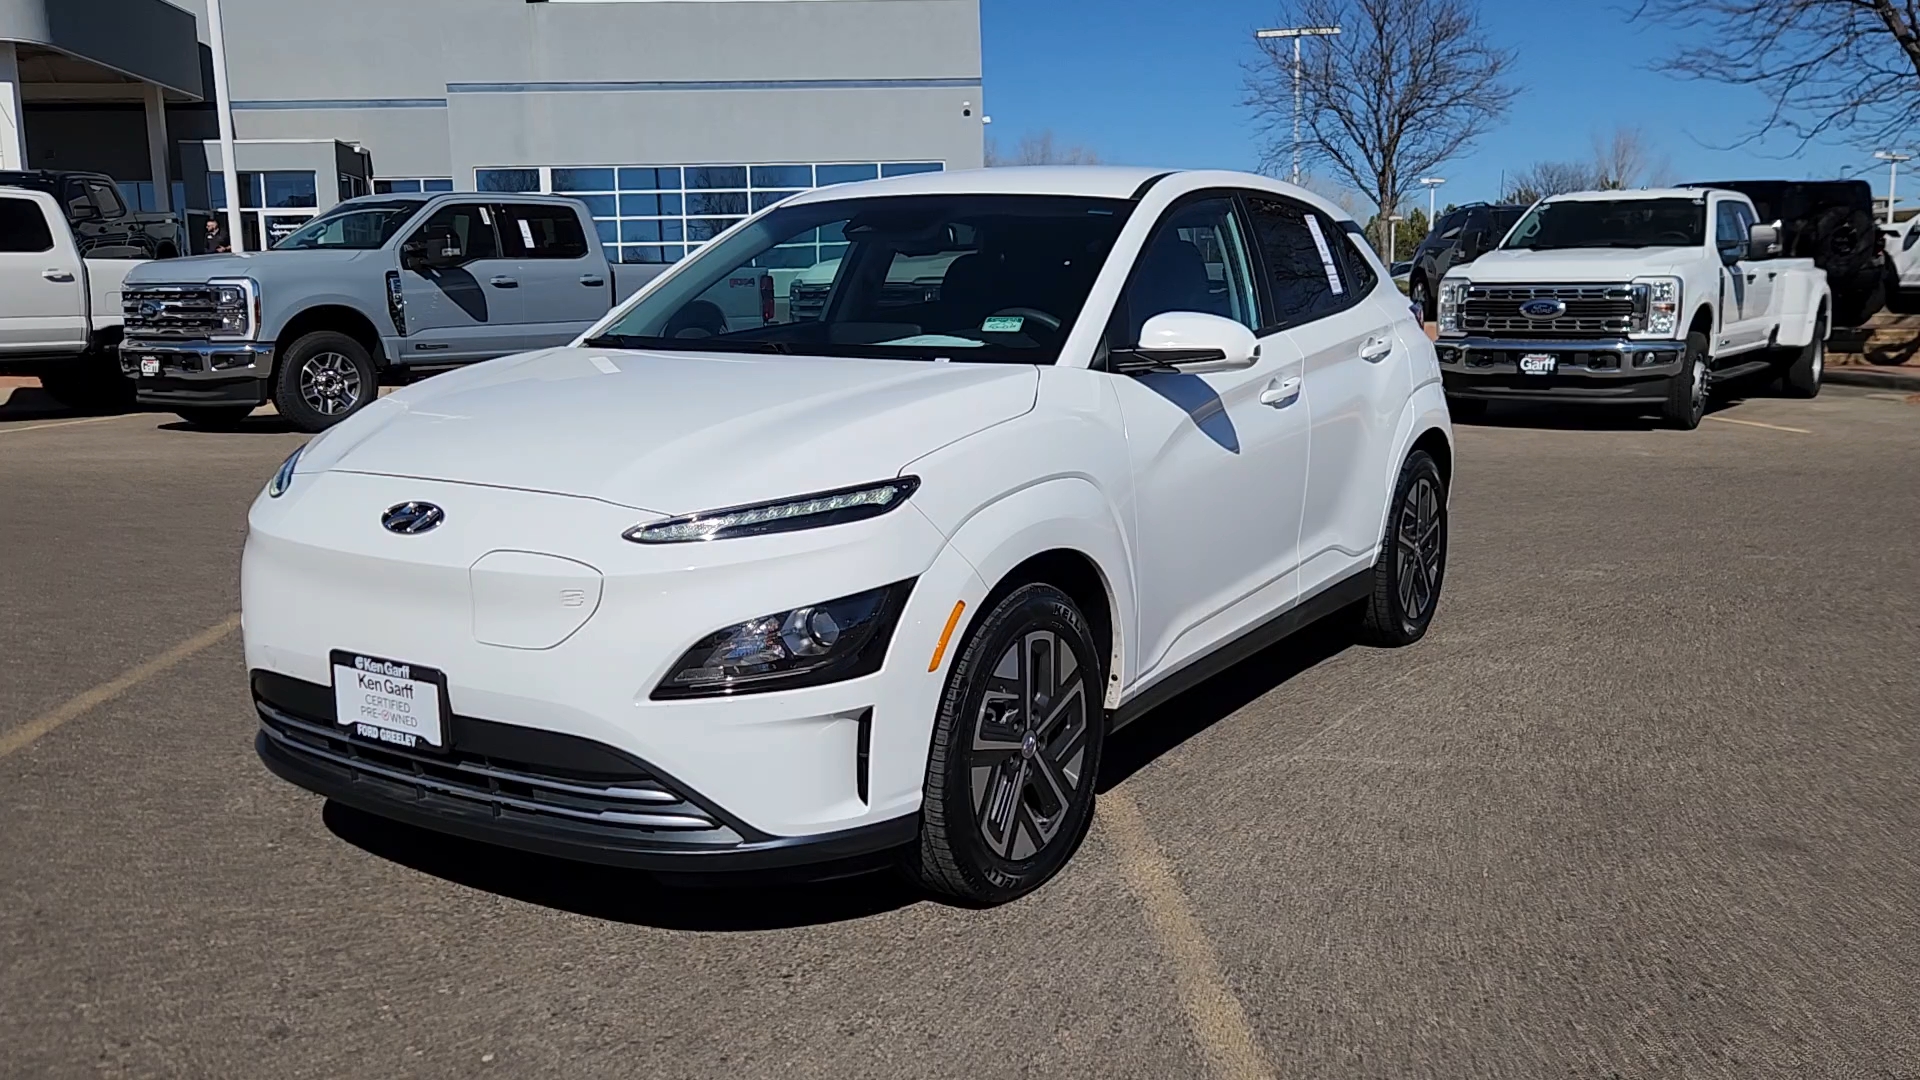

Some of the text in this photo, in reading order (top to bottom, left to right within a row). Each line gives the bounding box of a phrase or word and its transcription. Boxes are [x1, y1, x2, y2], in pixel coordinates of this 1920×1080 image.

[1520, 357, 1556, 371] Garff
[1053, 603, 1084, 633] KELLY
[364, 658, 410, 679] Ken Garff
[357, 673, 414, 699] Ken Garff
[365, 694, 411, 713] CERTIFIED
[357, 724, 417, 747] FORD GREELEY
